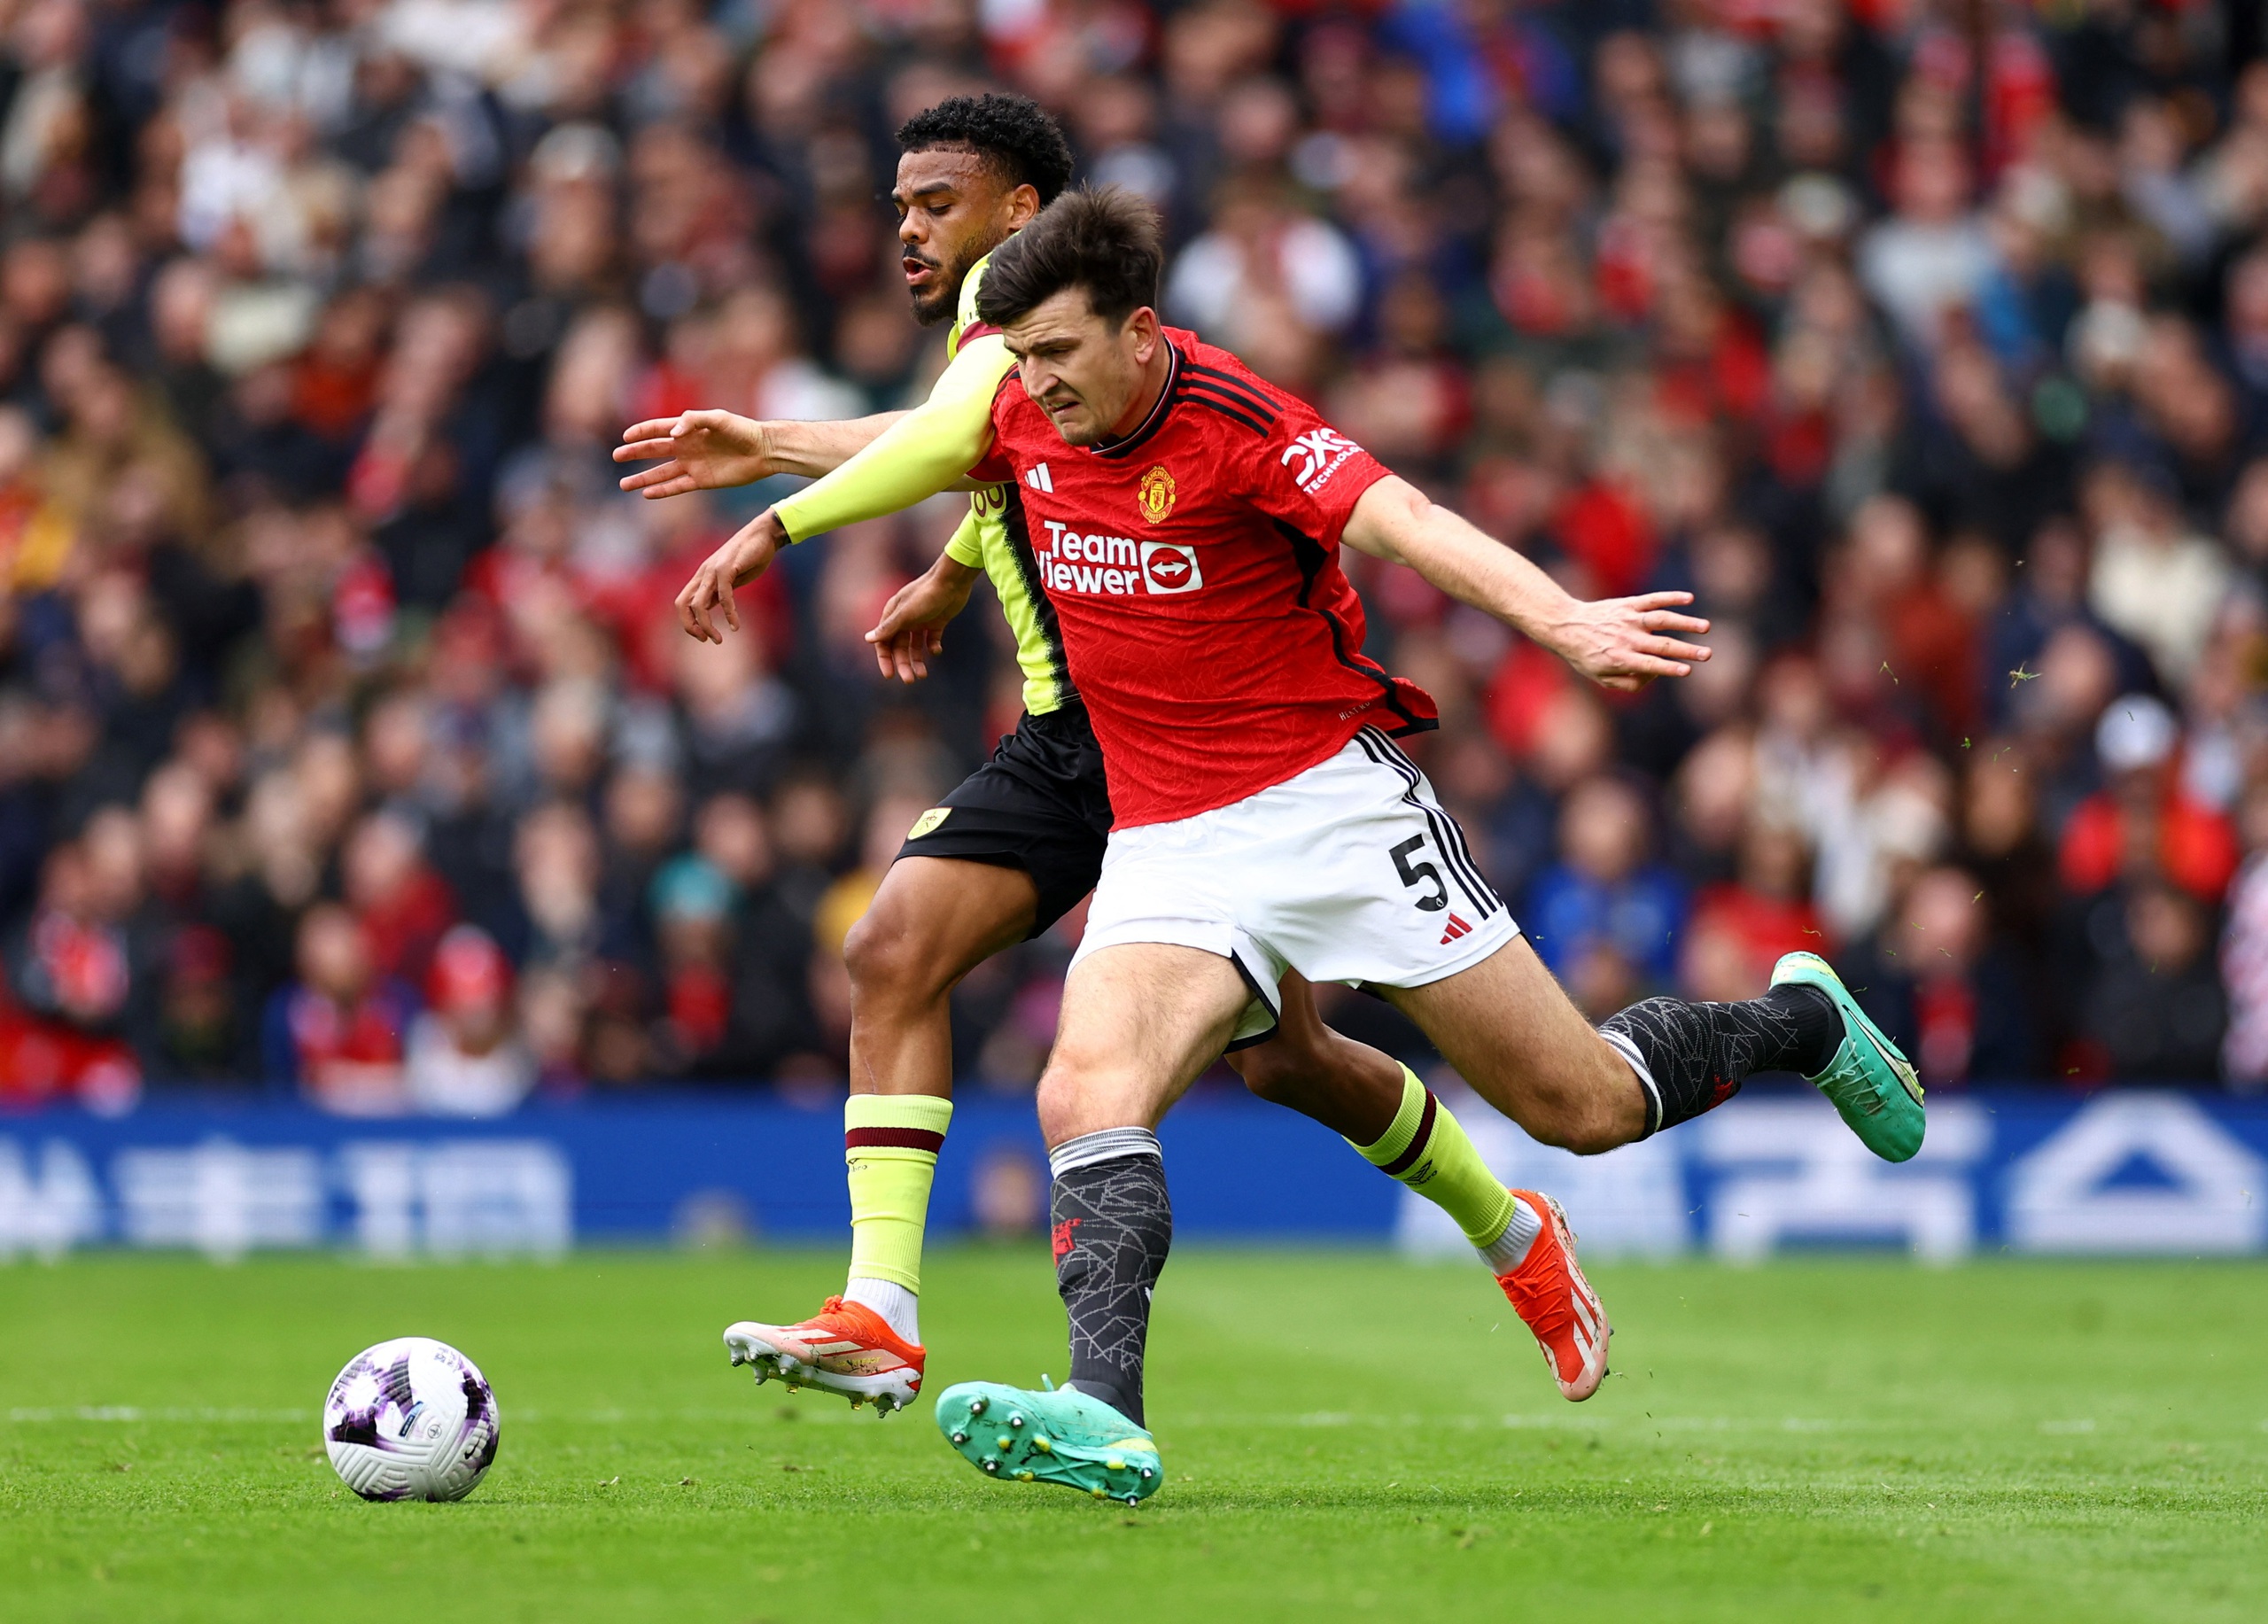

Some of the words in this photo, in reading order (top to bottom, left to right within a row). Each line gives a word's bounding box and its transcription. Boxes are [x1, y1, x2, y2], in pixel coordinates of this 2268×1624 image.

[1302, 446, 1365, 494] TECHNOLO
[1044, 520, 1138, 566] Team
[1388, 833, 1449, 912] 5
